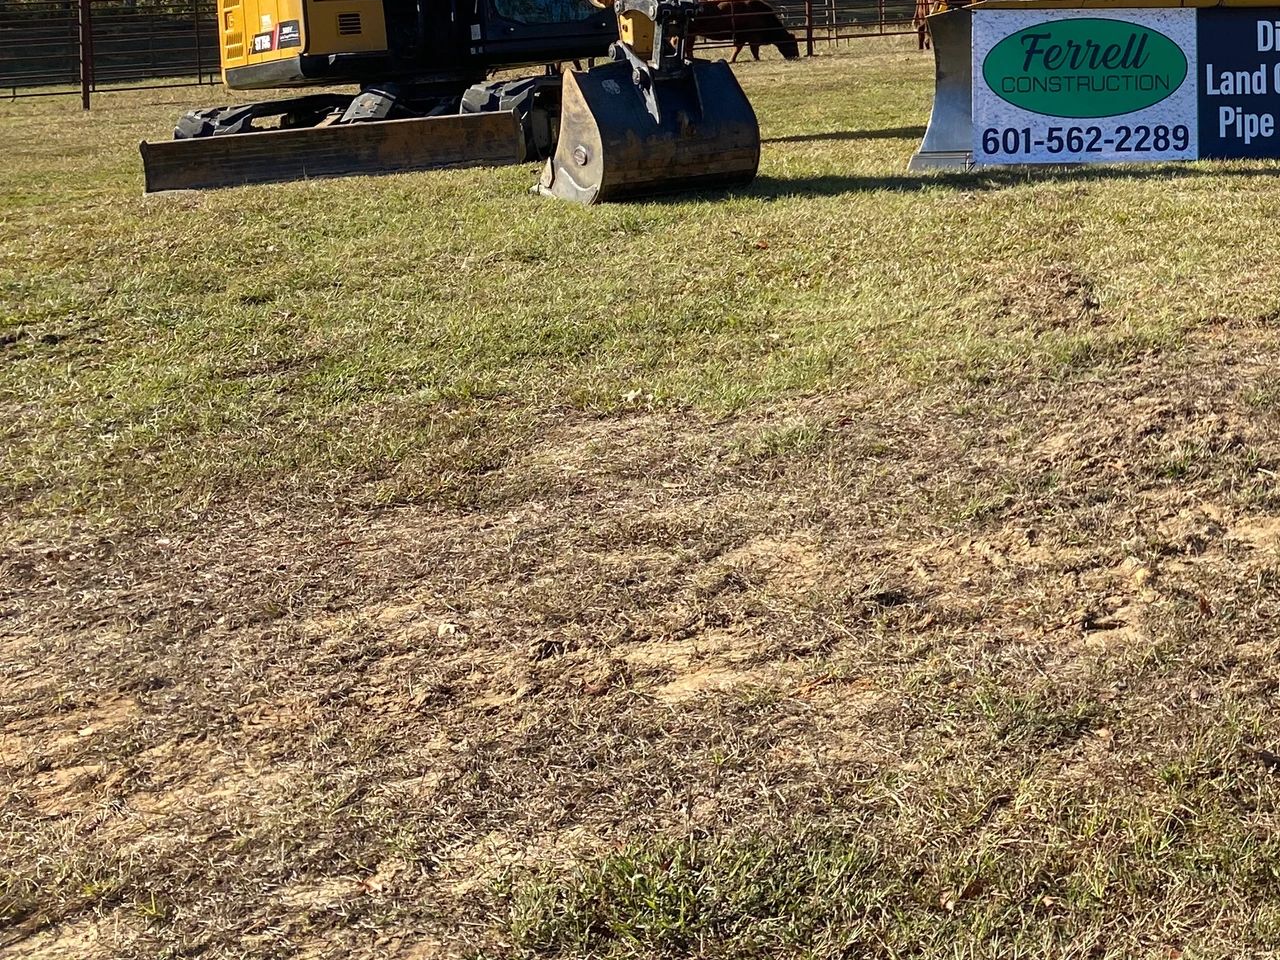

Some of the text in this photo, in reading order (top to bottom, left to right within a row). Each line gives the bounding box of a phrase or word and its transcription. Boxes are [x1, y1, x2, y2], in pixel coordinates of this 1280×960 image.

[1020, 33, 1149, 72] Ferrell
[1001, 74, 1170, 93] CONSTRUCTION
[1206, 63, 1267, 95] Land
[981, 124, 1190, 155] 601-562-2289
[1219, 106, 1275, 145] Pipe
